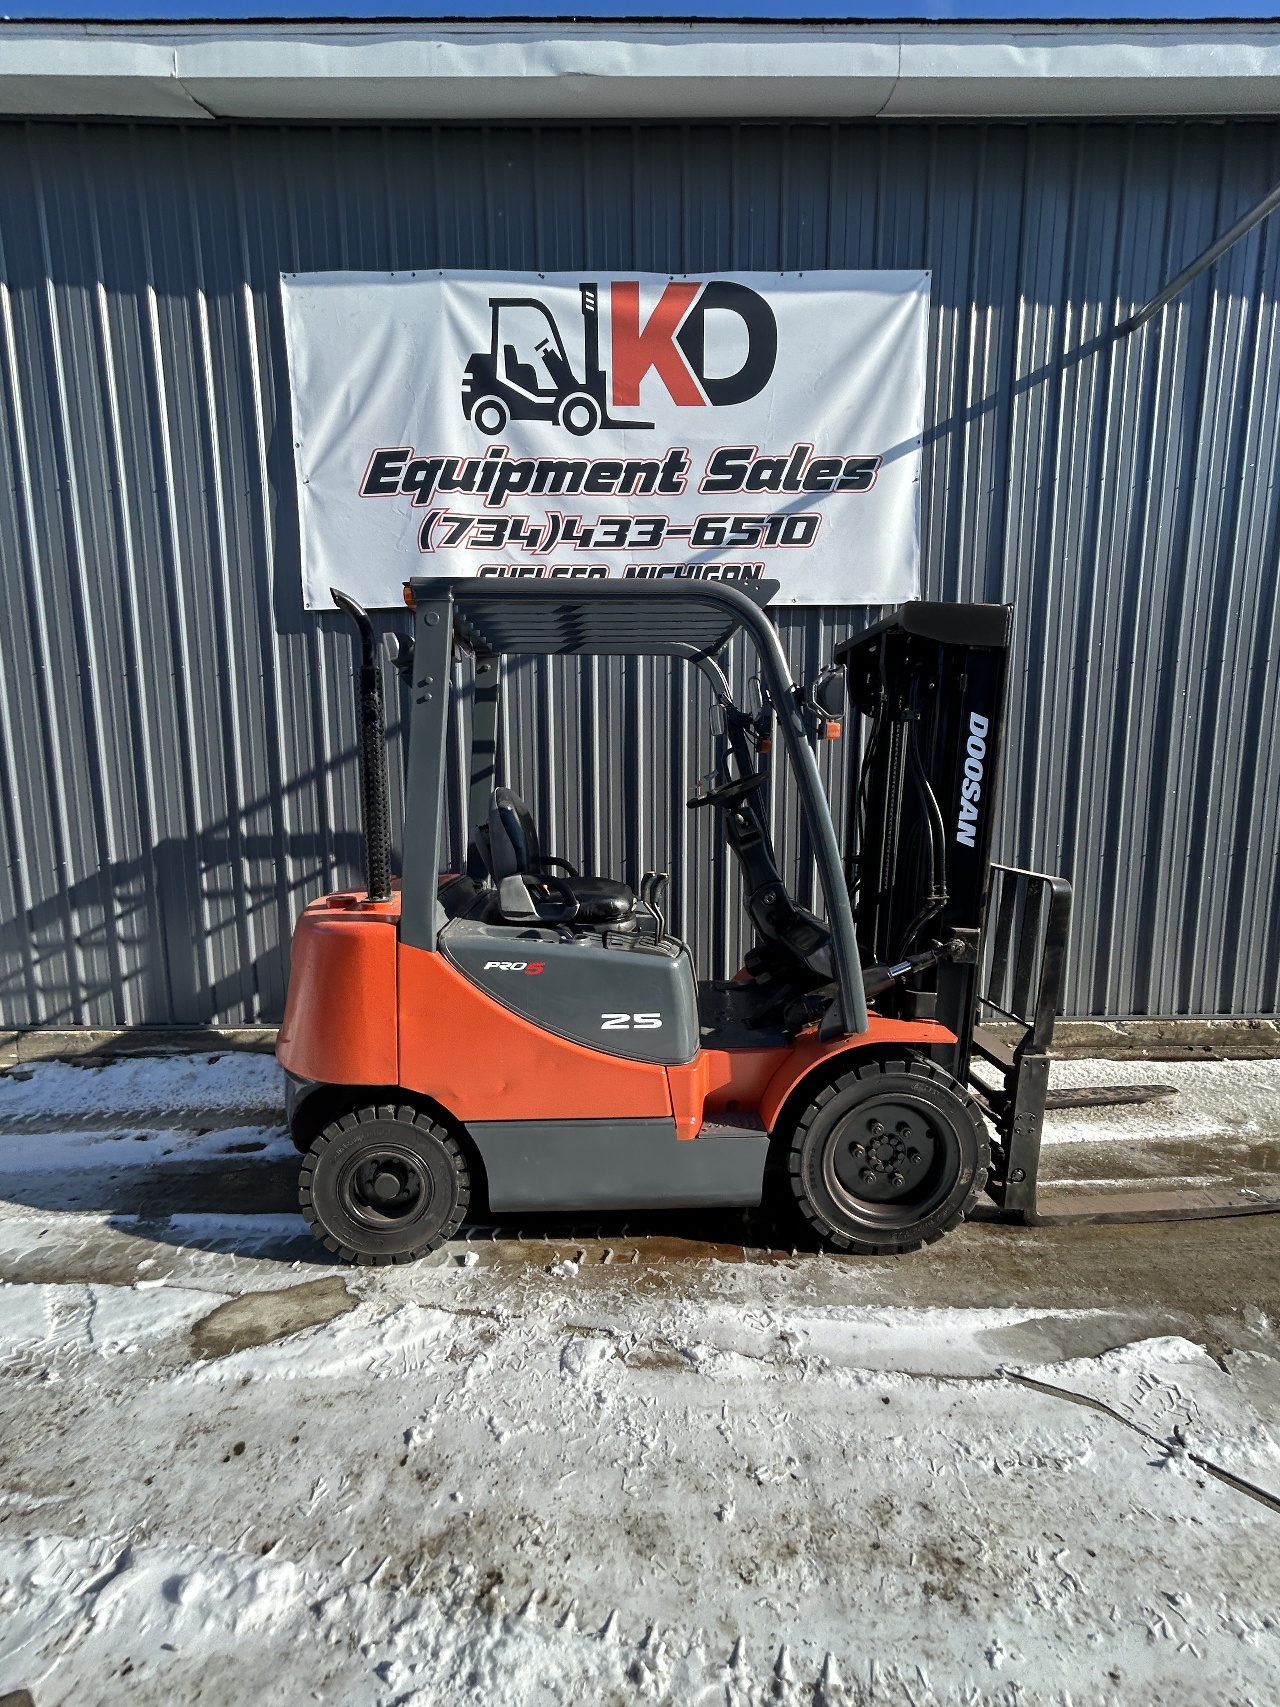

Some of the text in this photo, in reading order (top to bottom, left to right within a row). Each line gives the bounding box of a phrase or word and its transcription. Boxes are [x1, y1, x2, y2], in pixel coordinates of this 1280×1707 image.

[611, 280, 778, 407] KD
[361, 445, 881, 506] Equipment Sales
[419, 511, 821, 552] (734)433-6510
[956, 711, 989, 848] DOOSAN
[483, 961, 546, 976] PRO5
[600, 1012, 663, 1030] 25
